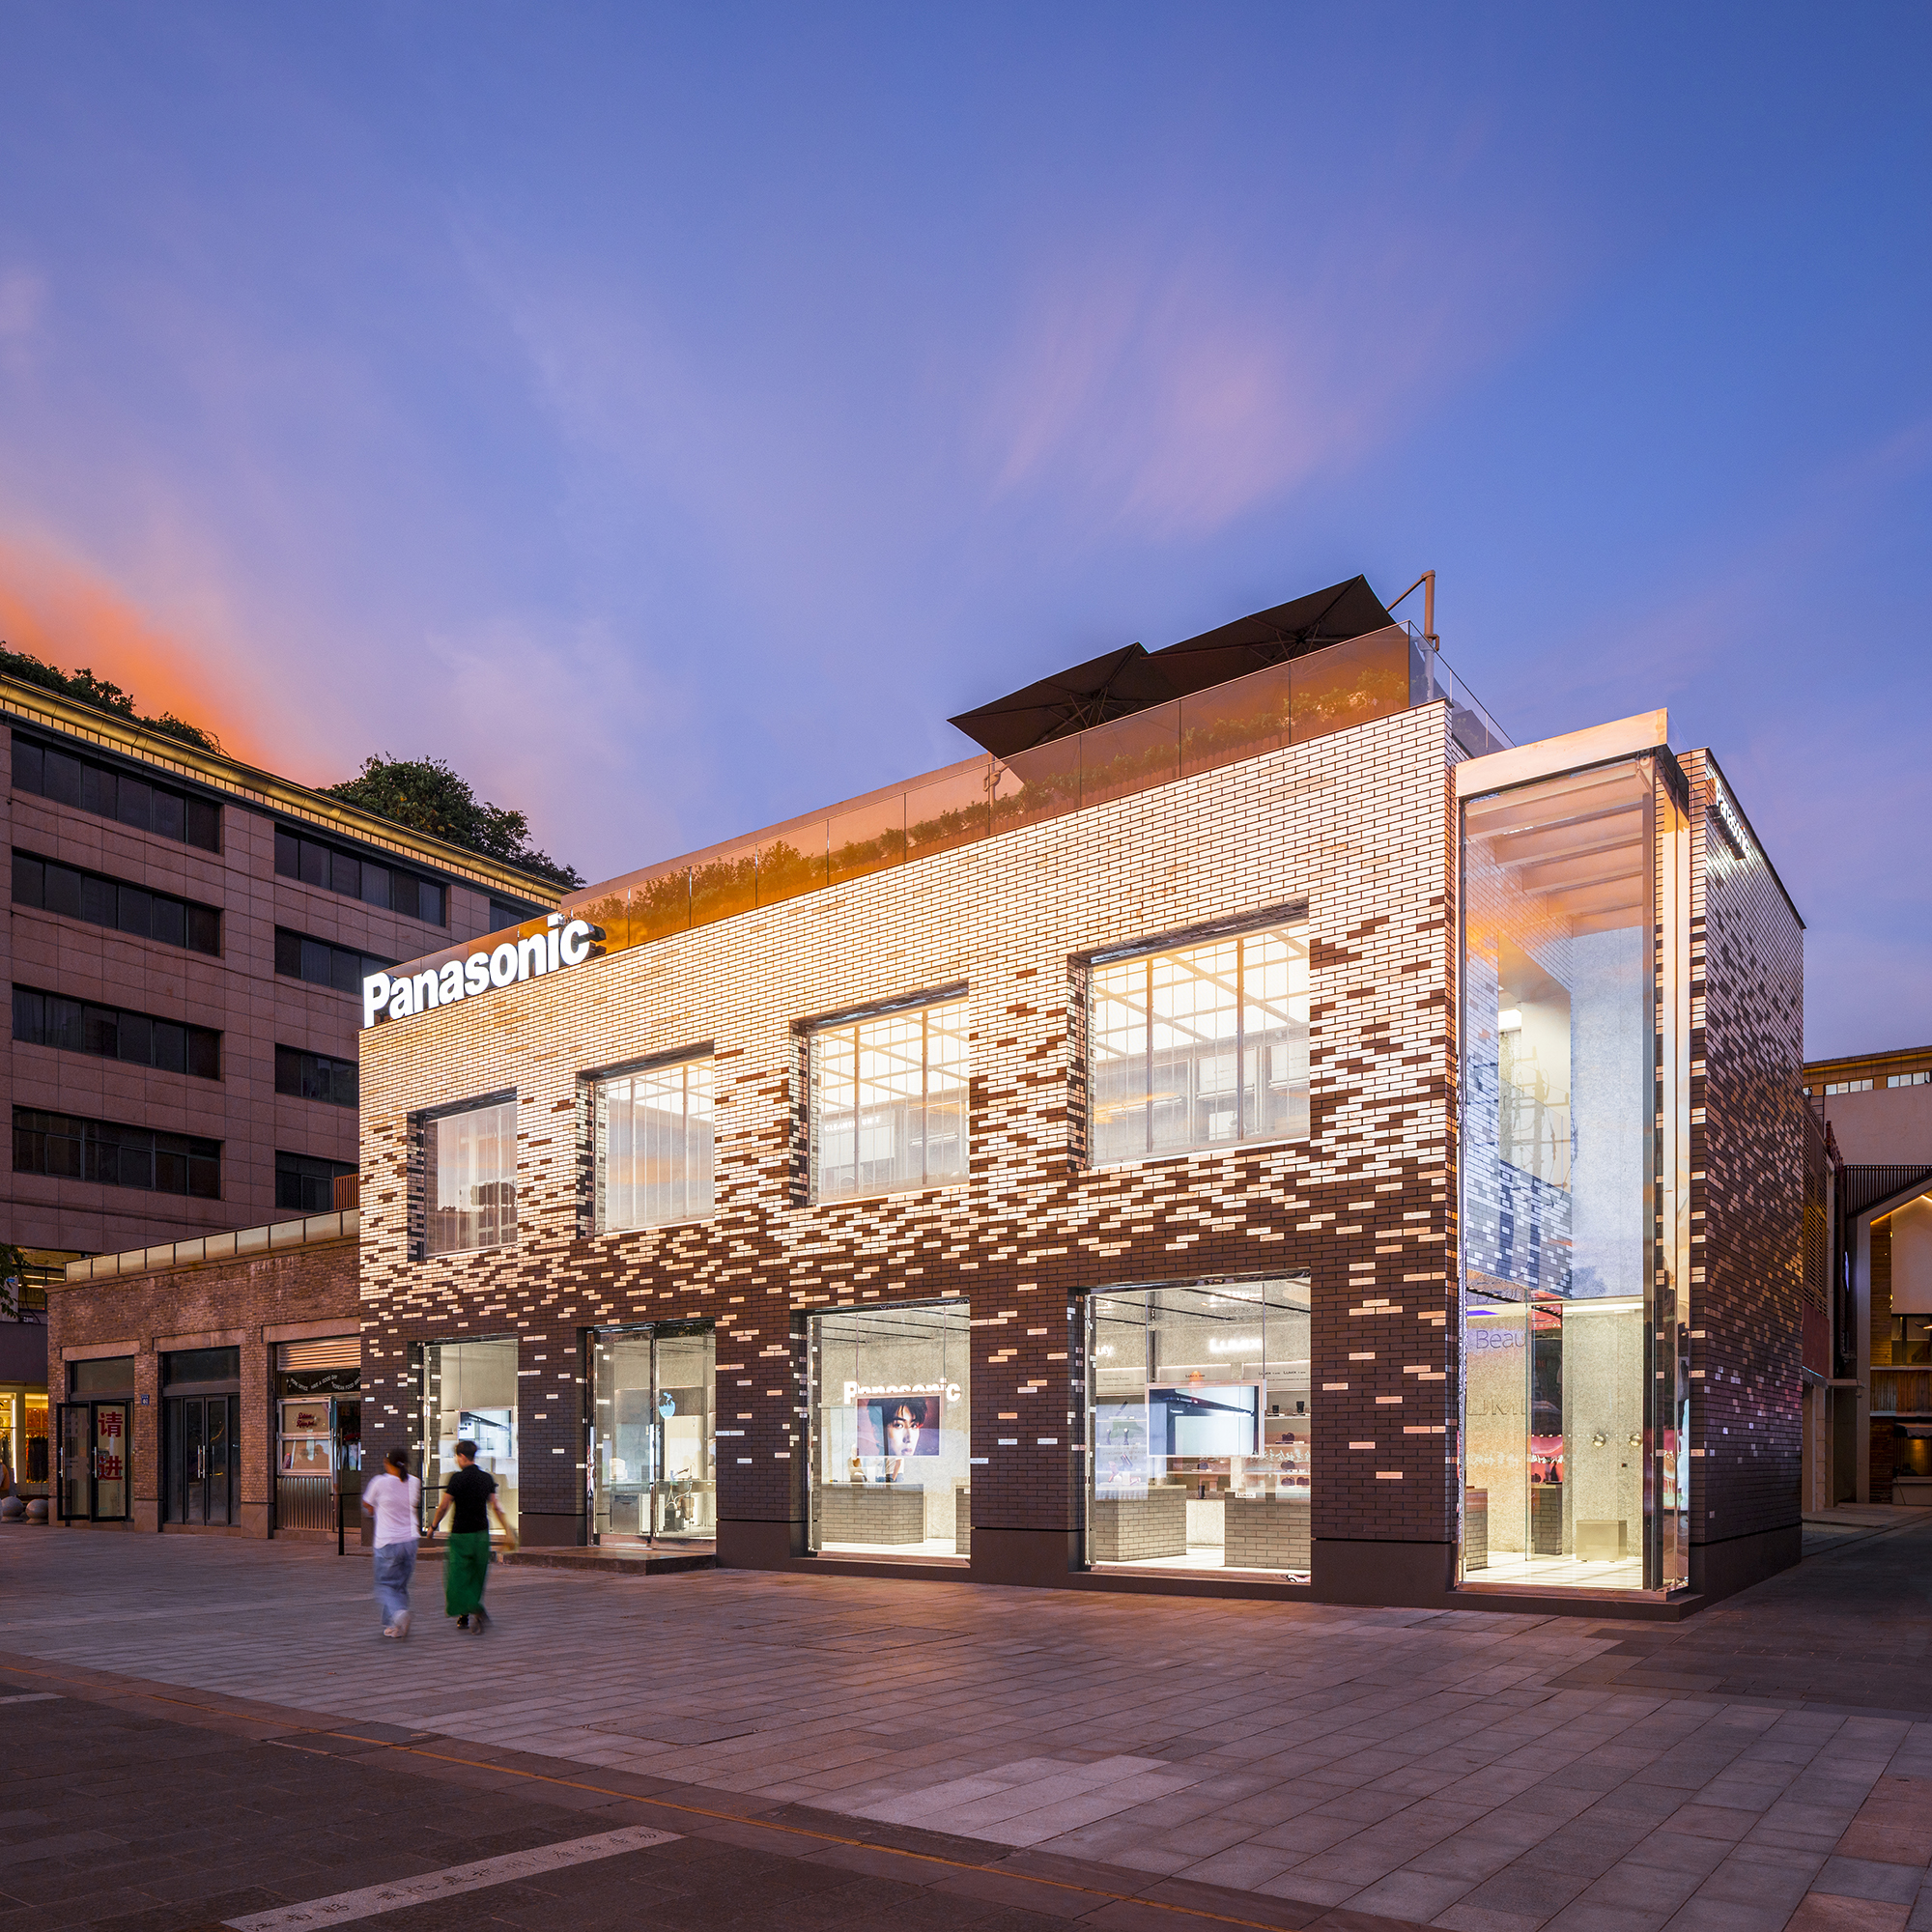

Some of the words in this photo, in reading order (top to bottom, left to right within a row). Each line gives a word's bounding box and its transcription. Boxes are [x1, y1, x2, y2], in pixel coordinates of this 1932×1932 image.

[1716, 777, 1749, 856] Panasonic
[363, 915, 590, 1029] Panasonic
[861, 1116, 880, 1126] UNT
[98, 1411, 124, 1481] 请进
